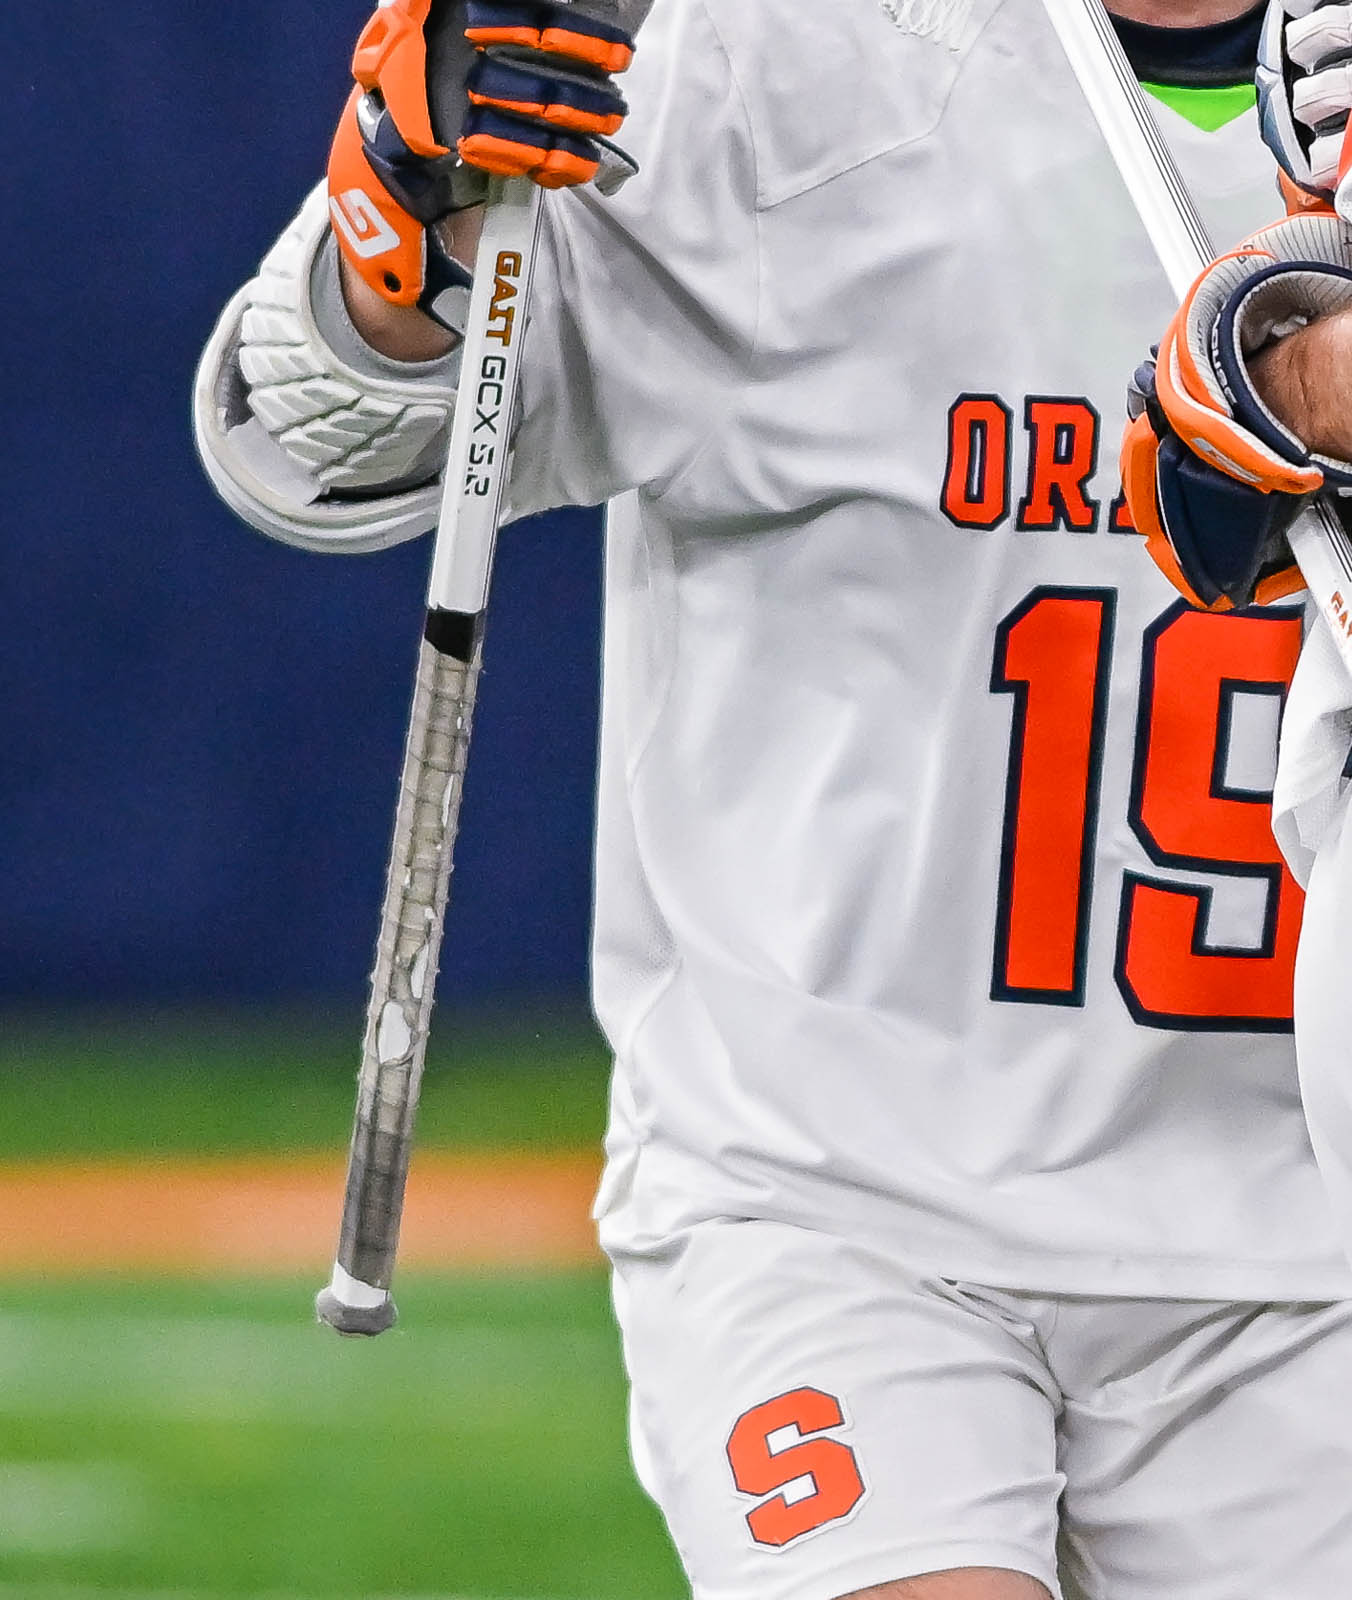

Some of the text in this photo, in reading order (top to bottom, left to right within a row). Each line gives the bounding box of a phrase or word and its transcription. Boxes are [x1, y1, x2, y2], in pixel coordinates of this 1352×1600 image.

[485, 250, 523, 347] GAIT
[472, 355, 507, 435] GCX
[940, 392, 1138, 533] OR
[989, 584, 1305, 1033] 19
[724, 1385, 866, 1548] S
